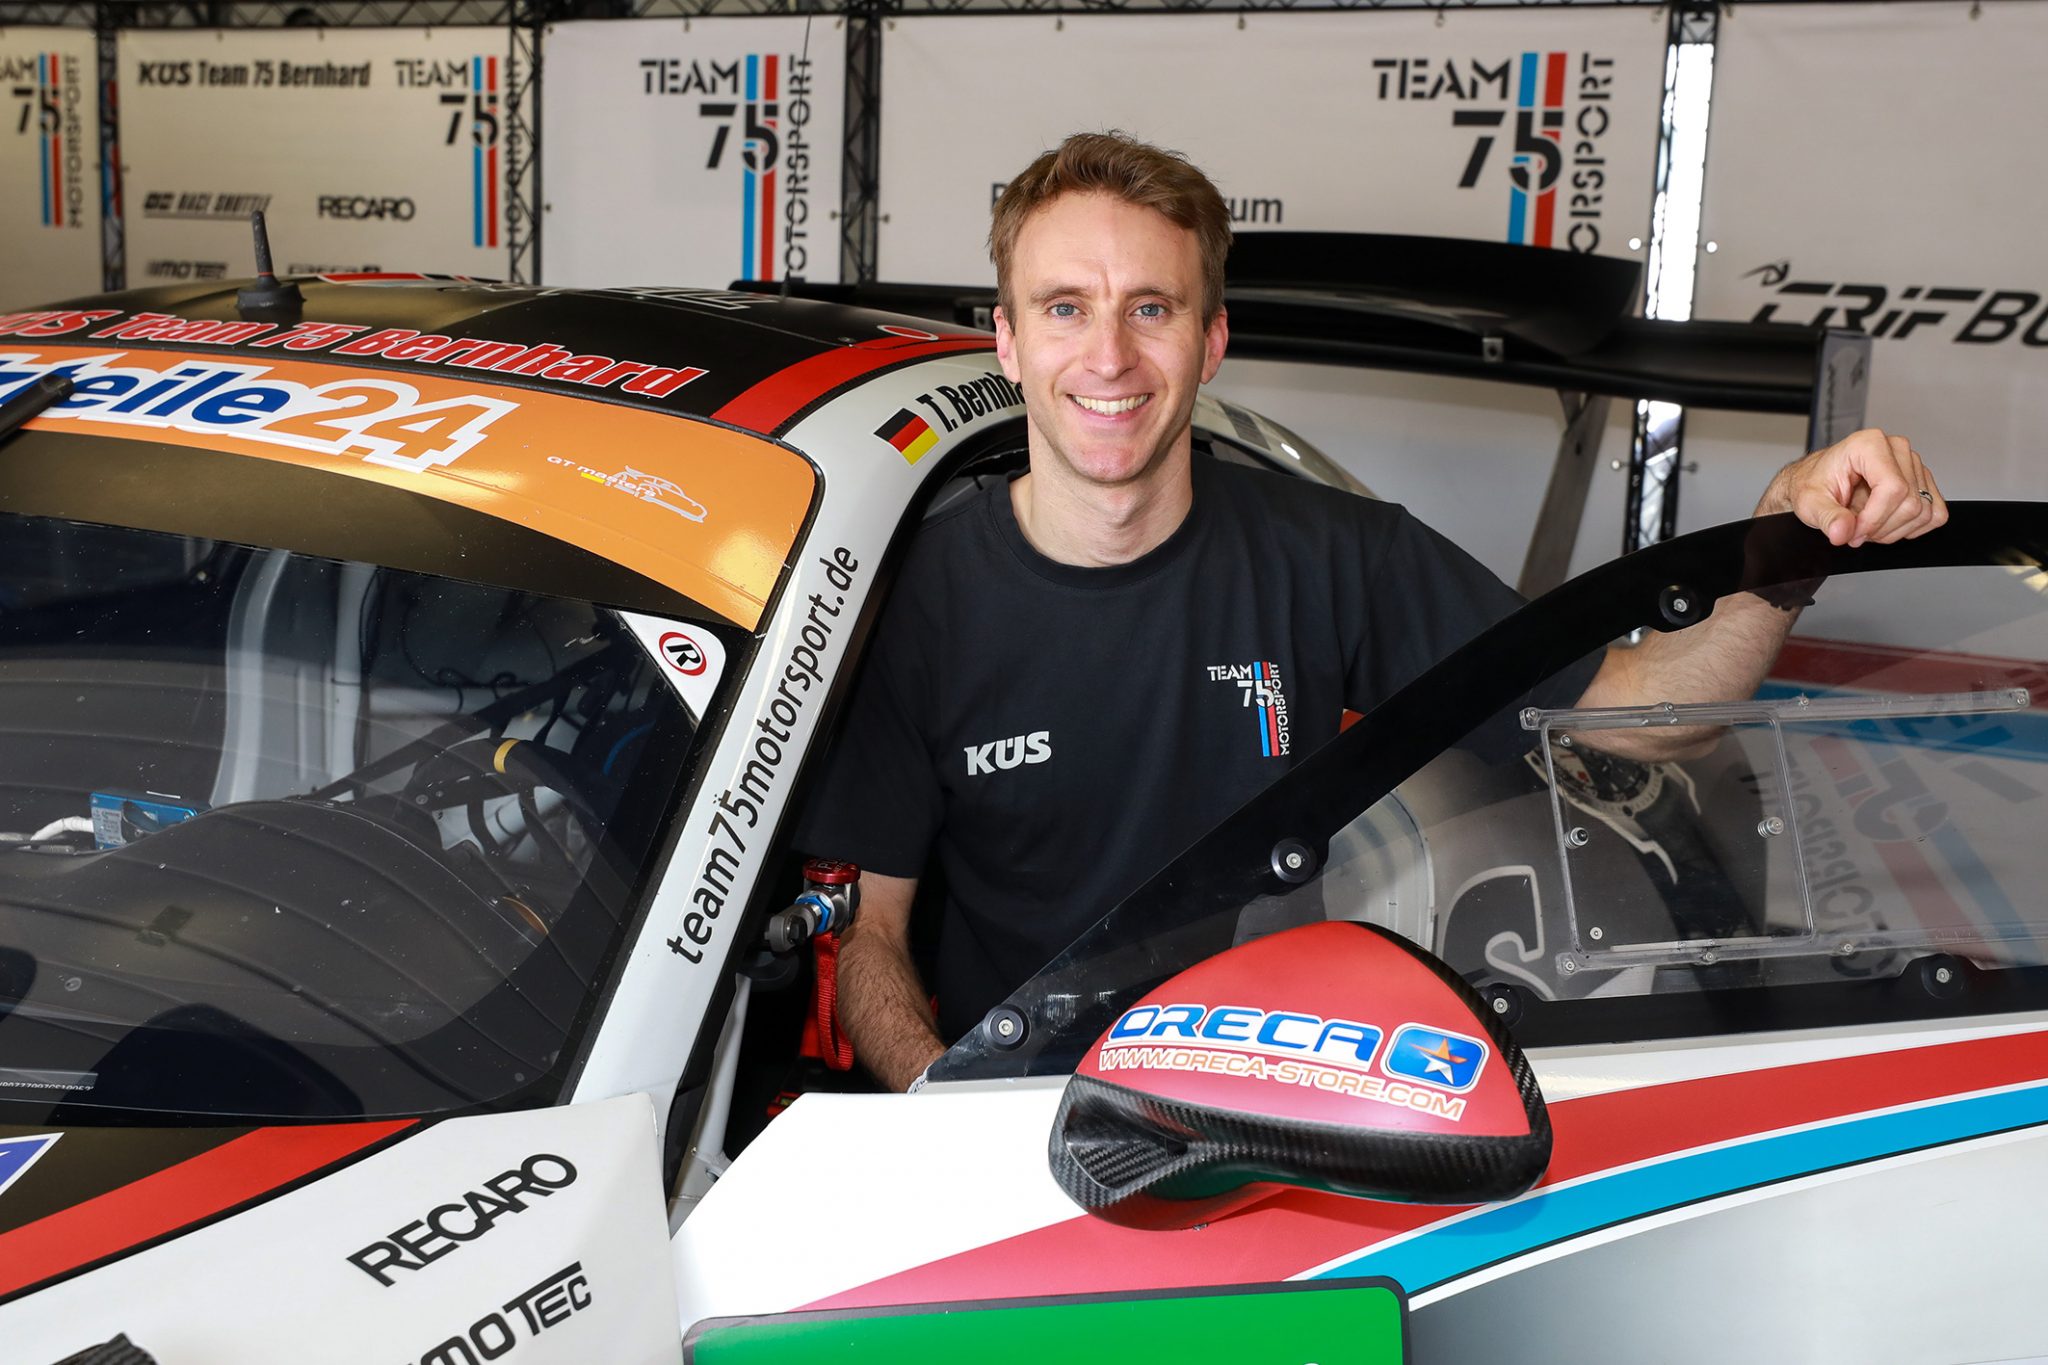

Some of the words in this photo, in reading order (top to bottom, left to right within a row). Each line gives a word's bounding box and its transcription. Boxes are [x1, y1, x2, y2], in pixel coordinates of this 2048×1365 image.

[0, 56, 36, 82] AM
[198, 60, 248, 87] Team
[253, 60, 275, 87] 75
[279, 60, 370, 88] Bernhard
[394, 60, 468, 87] TEAM
[640, 59, 739, 95] TEAM
[1372, 58, 1511, 100] TEAM
[12, 86, 61, 135] 75
[440, 94, 498, 146] 75
[699, 103, 780, 171] 75
[1453, 109, 1566, 192] 75
[1567, 52, 1614, 256] ORSPORT
[784, 54, 812, 281] OTORSPORT
[317, 195, 416, 221] RECARO
[88, 312, 279, 346] Team
[248, 321, 372, 351] 75
[330, 328, 709, 399] Bernhard
[915, 393, 959, 433] T.
[546, 455, 577, 467] GT
[577, 464, 657, 498] masters
[1207, 664, 1253, 681] TEAM
[1237, 680, 1275, 708] 75
[1268, 662, 1290, 756] MOTORSPORT
[666, 545, 859, 965] team75motorsport.de
[964, 730, 1052, 776] KÜS
[1106, 1006, 1383, 1065] ORECA
[1100, 1049, 1466, 1121] WWW.ORECA-STORE.COM
[346, 1153, 578, 1288] RECARO
